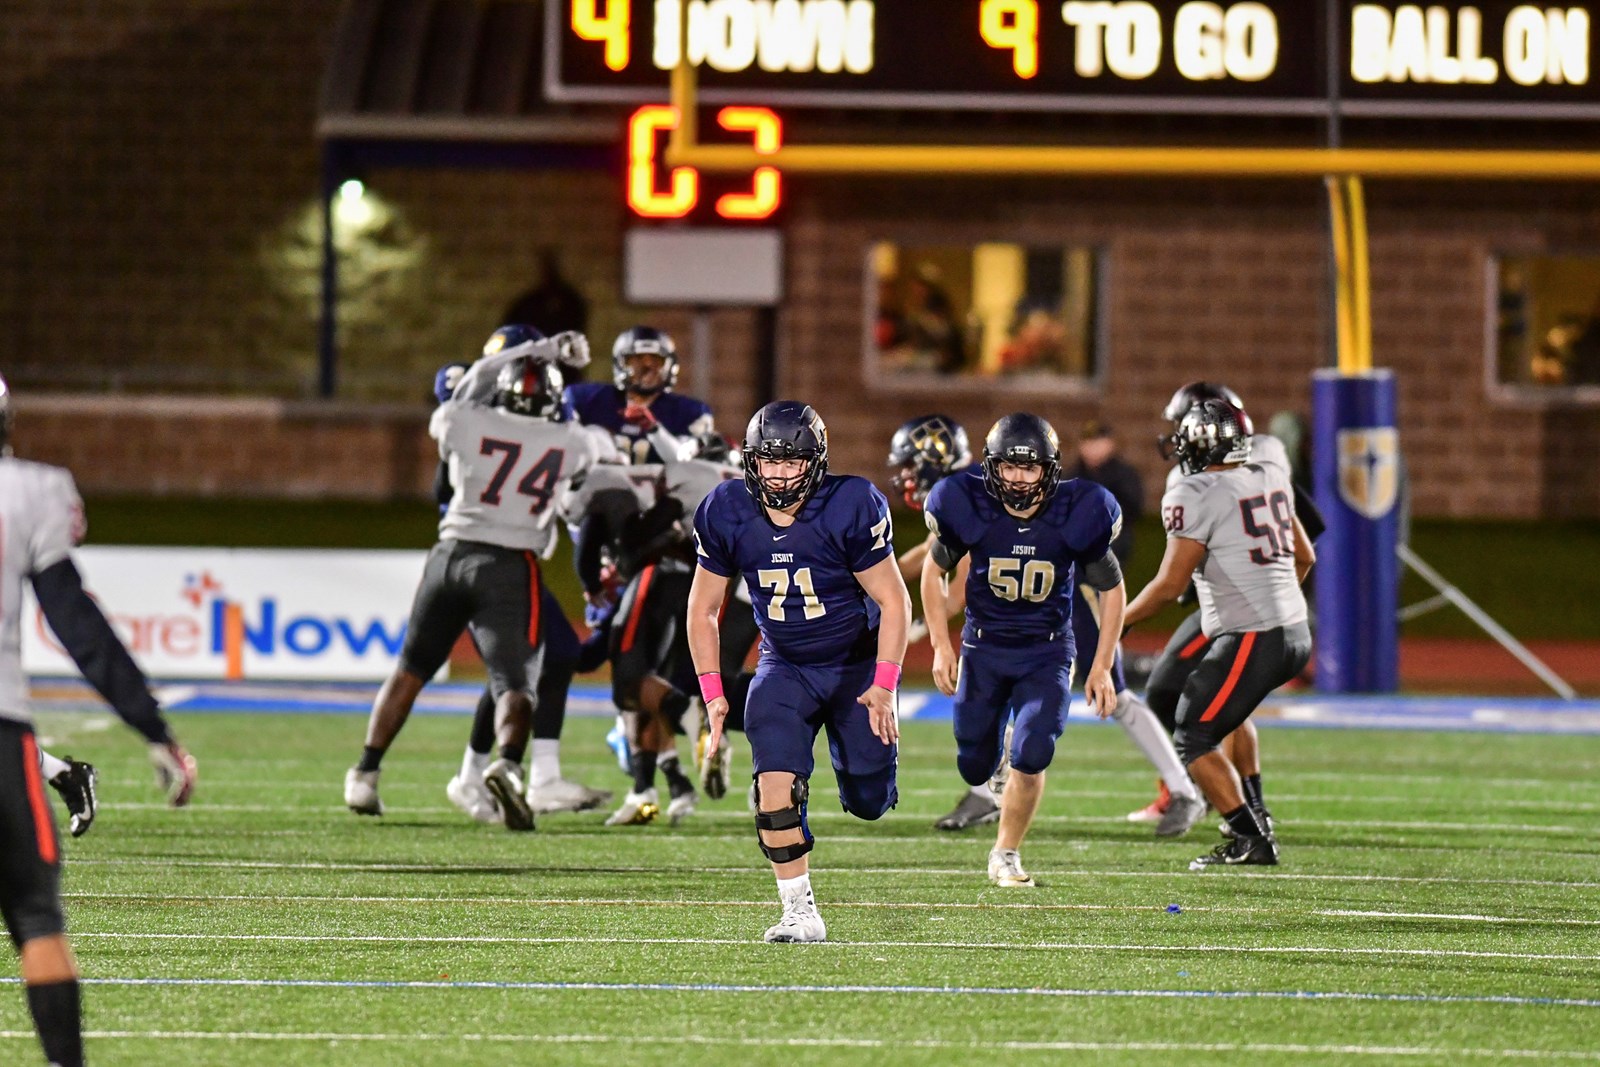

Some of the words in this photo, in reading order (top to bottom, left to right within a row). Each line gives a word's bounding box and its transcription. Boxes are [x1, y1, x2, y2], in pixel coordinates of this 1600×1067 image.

[571, 0, 629, 71] 4
[979, 0, 1038, 79] 9
[1061, 1, 1162, 79] TO
[1173, 2, 1278, 81] GO
[1350, 3, 1498, 83] BALL
[1503, 5, 1590, 85] ON
[479, 436, 565, 516] 74
[1163, 506, 1184, 531] 58
[1239, 490, 1295, 566] 58
[771, 553, 794, 563] JESUIT
[988, 557, 1055, 603] 50
[1011, 545, 1036, 555] JESUIT
[757, 567, 827, 621] 71
